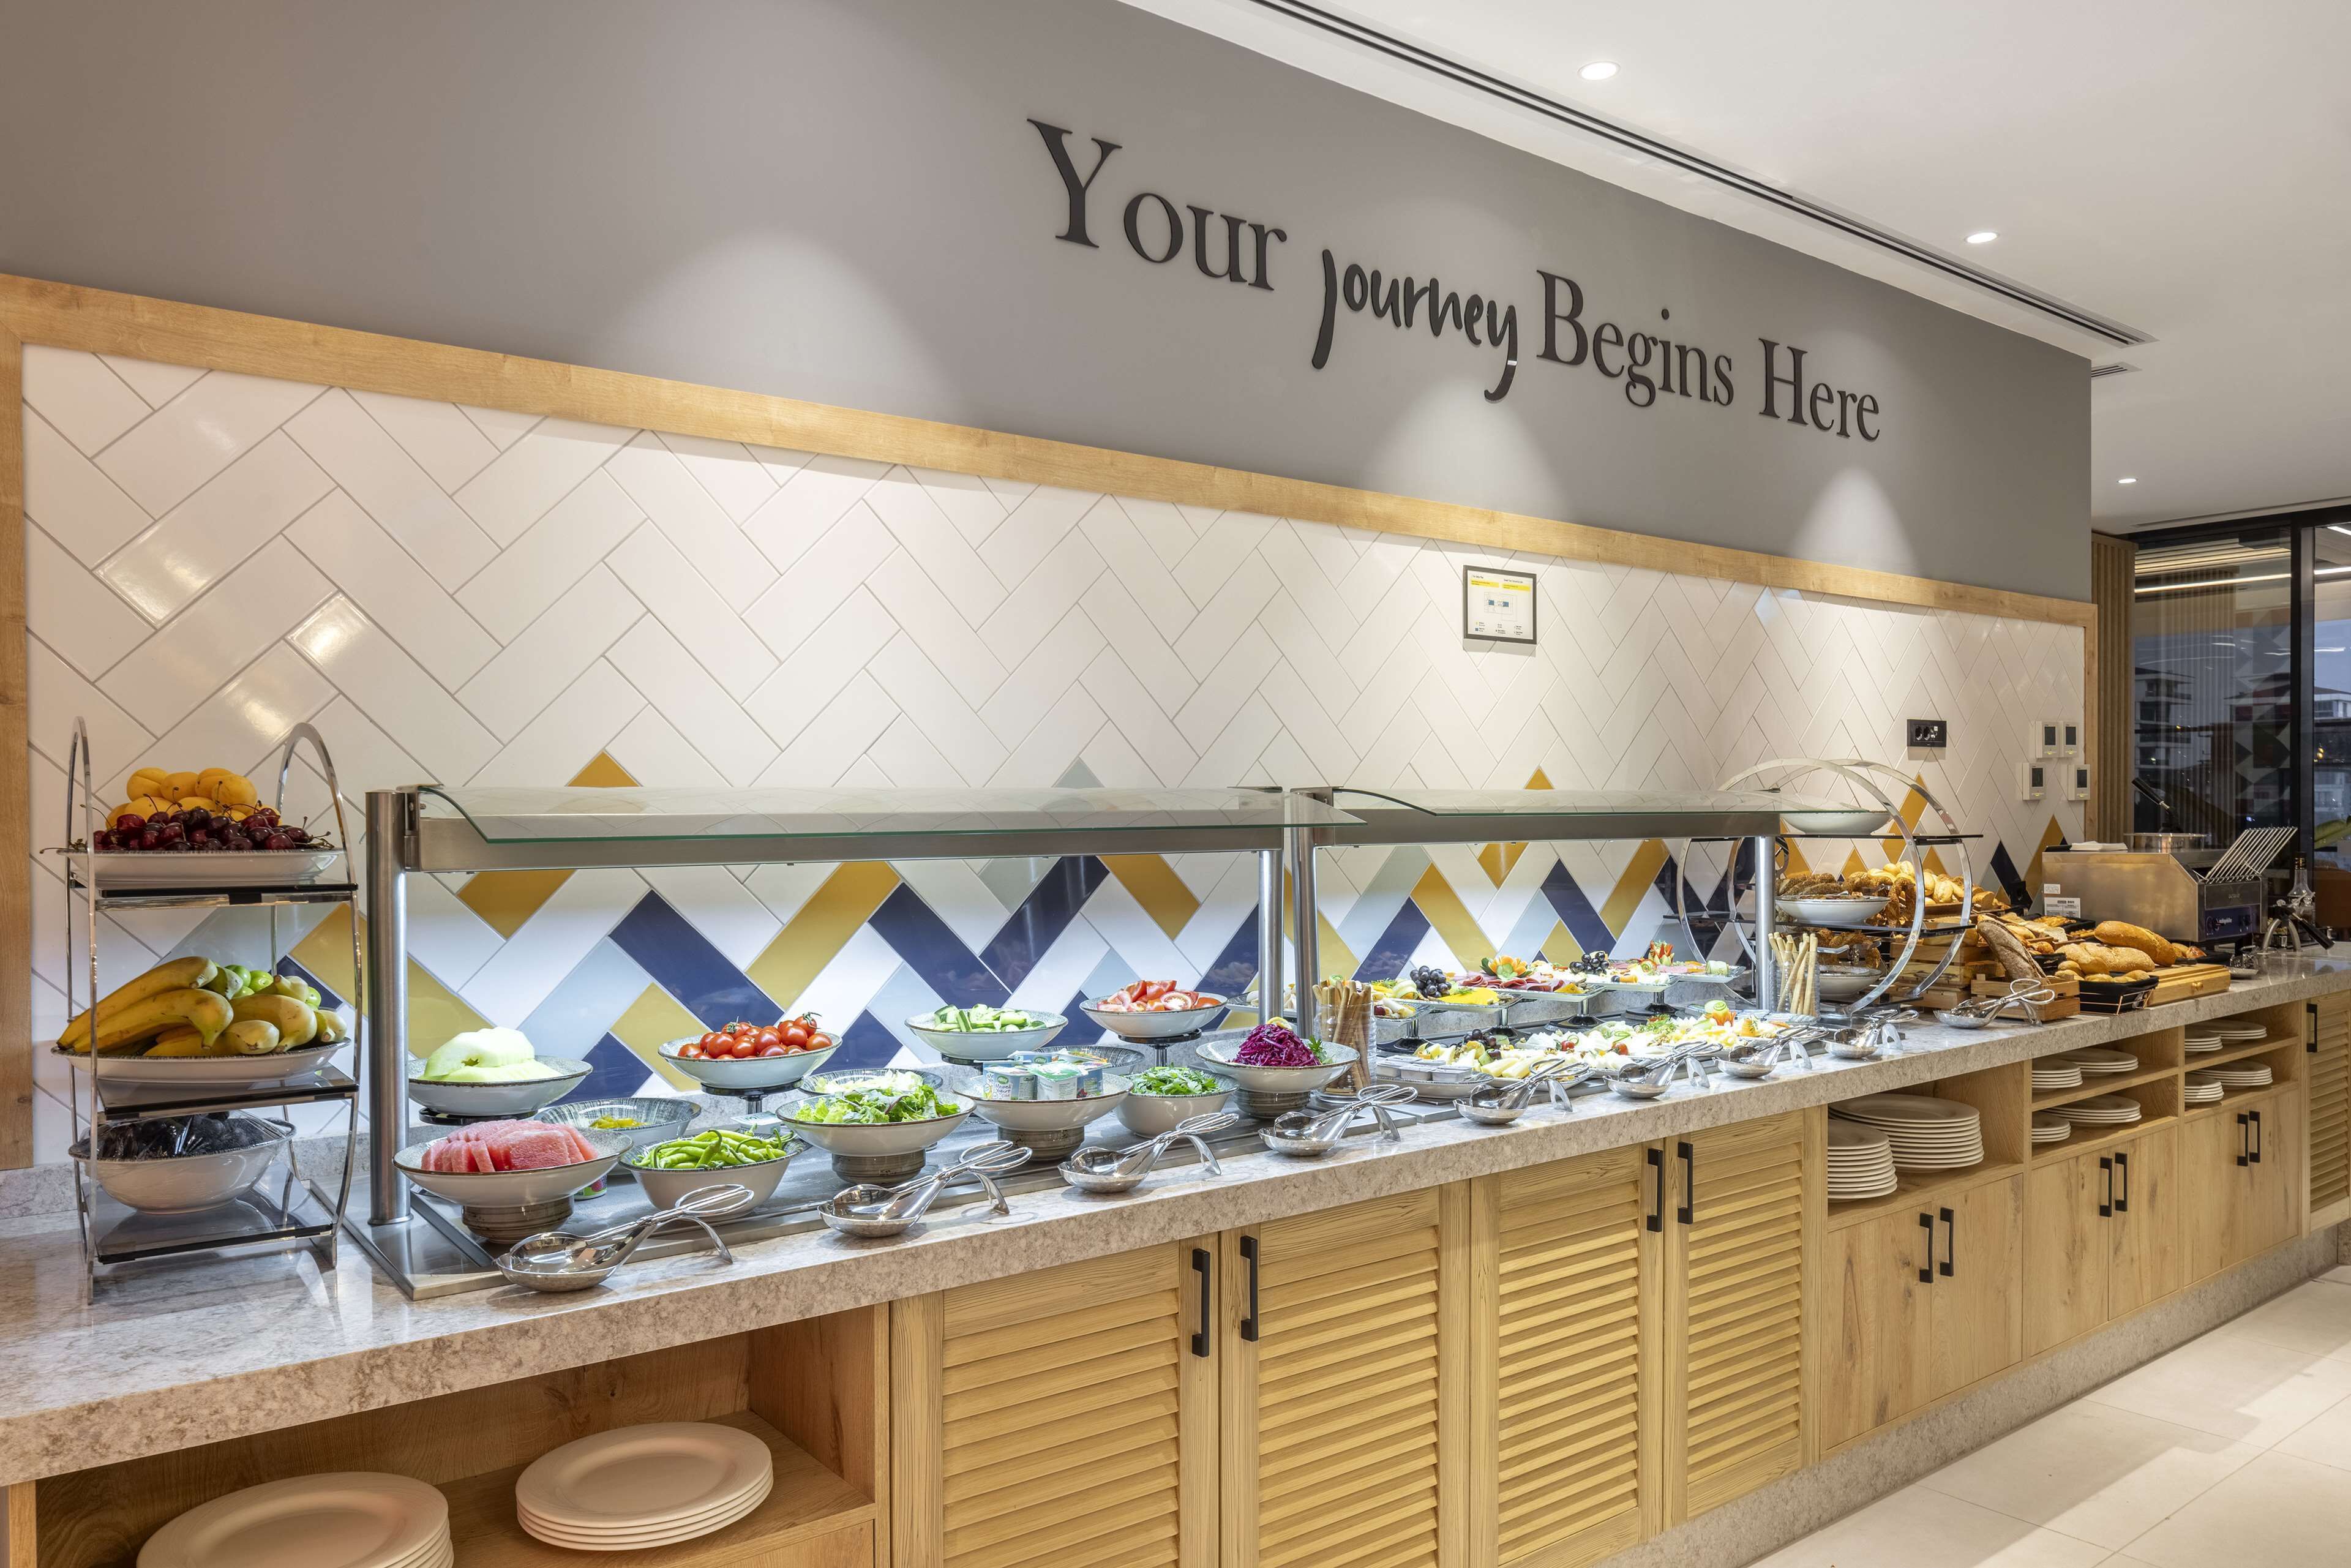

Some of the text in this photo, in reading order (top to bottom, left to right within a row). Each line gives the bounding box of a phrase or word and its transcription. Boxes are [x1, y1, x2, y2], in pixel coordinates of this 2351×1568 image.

[1026, 118, 1881, 442] Your journey Begins Here
